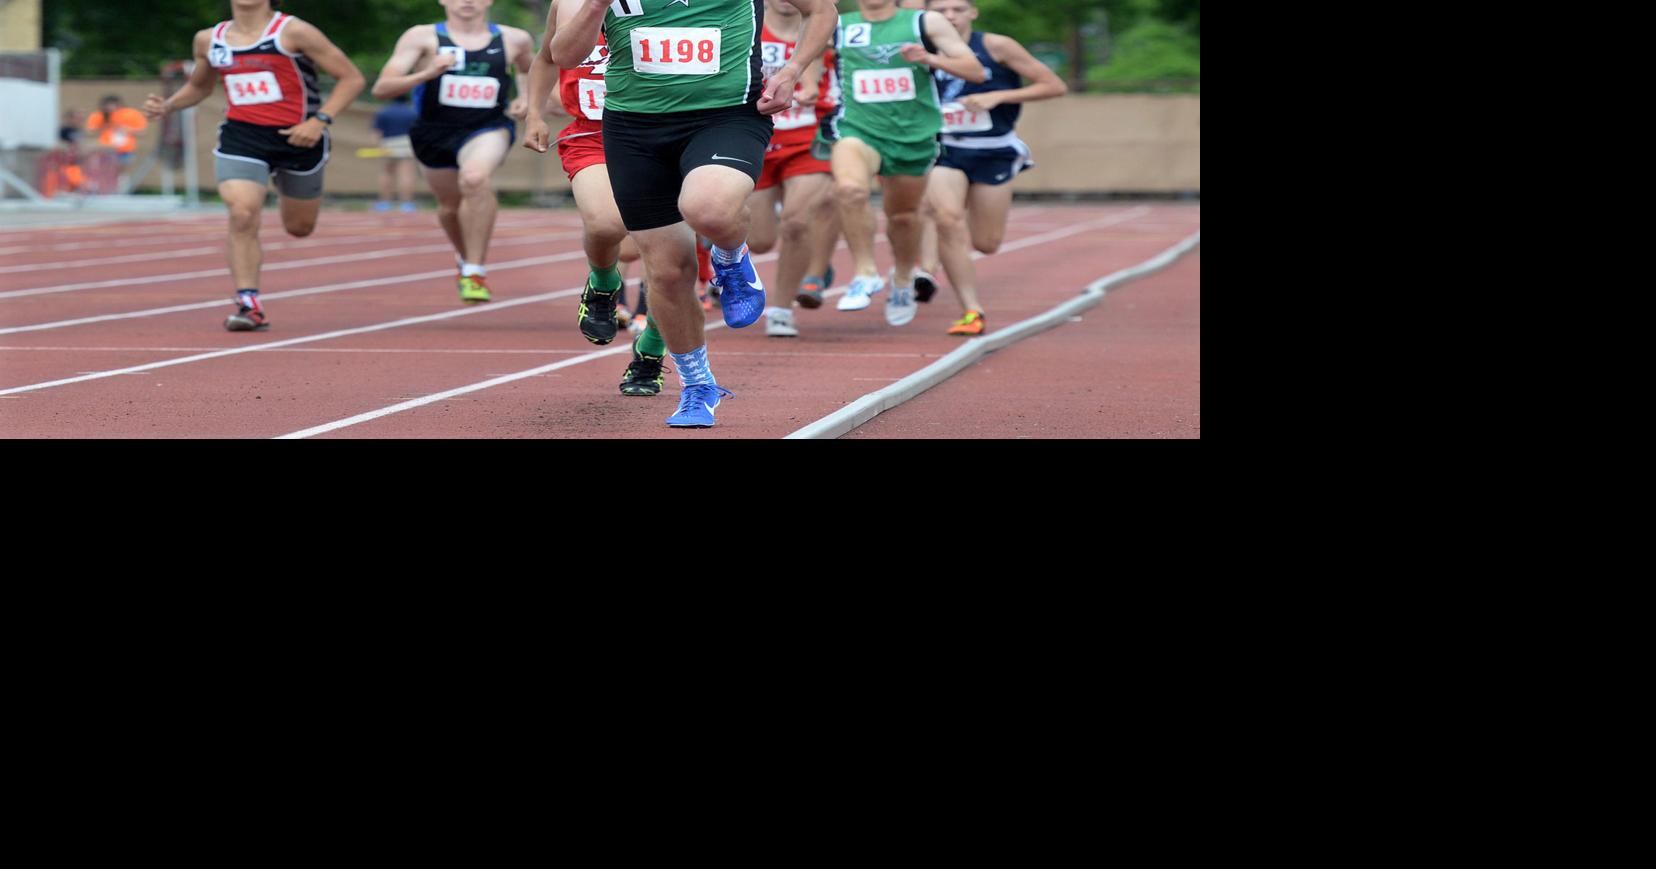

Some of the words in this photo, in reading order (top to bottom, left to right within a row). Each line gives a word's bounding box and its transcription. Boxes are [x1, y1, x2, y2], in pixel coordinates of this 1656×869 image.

[849, 26, 864, 44] 2
[640, 39, 714, 63] 1198
[763, 45, 779, 63] 3
[234, 81, 269, 97] 944
[447, 83, 496, 101] 1060
[859, 76, 910, 95] 1189
